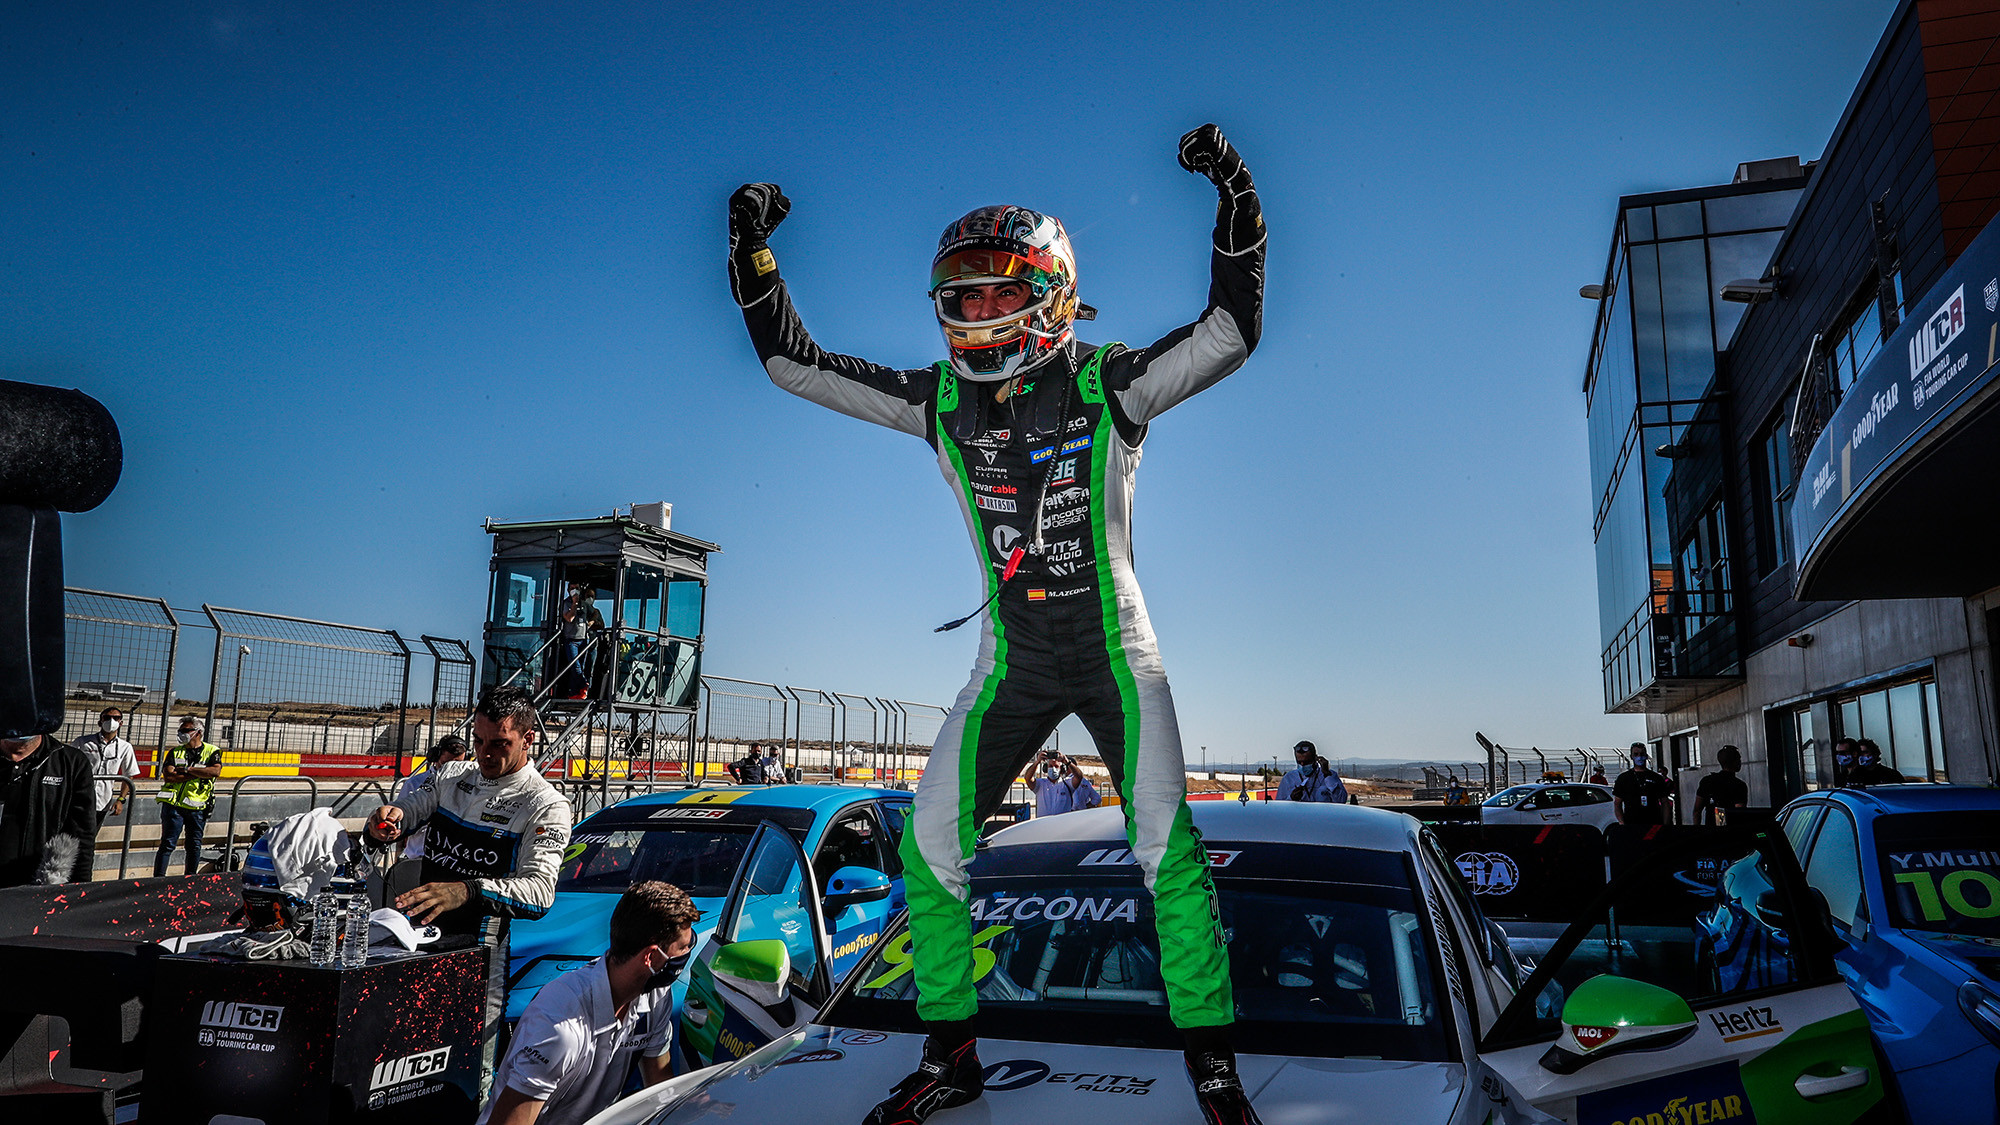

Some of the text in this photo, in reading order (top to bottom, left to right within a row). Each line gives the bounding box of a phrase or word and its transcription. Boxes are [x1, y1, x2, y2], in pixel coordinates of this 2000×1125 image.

[1908, 282, 1966, 382] WTCR
[1852, 382, 1899, 450] GOODYEAR
[1032, 438, 1090, 461] GOOYEAR
[970, 481, 1018, 495] navarcable
[1047, 586, 1091, 598] M.AZCONA
[200, 1000, 286, 1033] WTCR
[1708, 1005, 1780, 1036] Hertz
[217, 1030, 254, 1041] FIA WORLD
[1577, 1027, 1603, 1038] MOL
[216, 1040, 276, 1053] TOURING CAR CUP
[369, 1045, 452, 1091] WTCR
[387, 1083, 445, 1106] TOURING CAR CUP
[400, 1080, 425, 1094] WORLD
[1074, 1084, 1151, 1096] AUDIO
